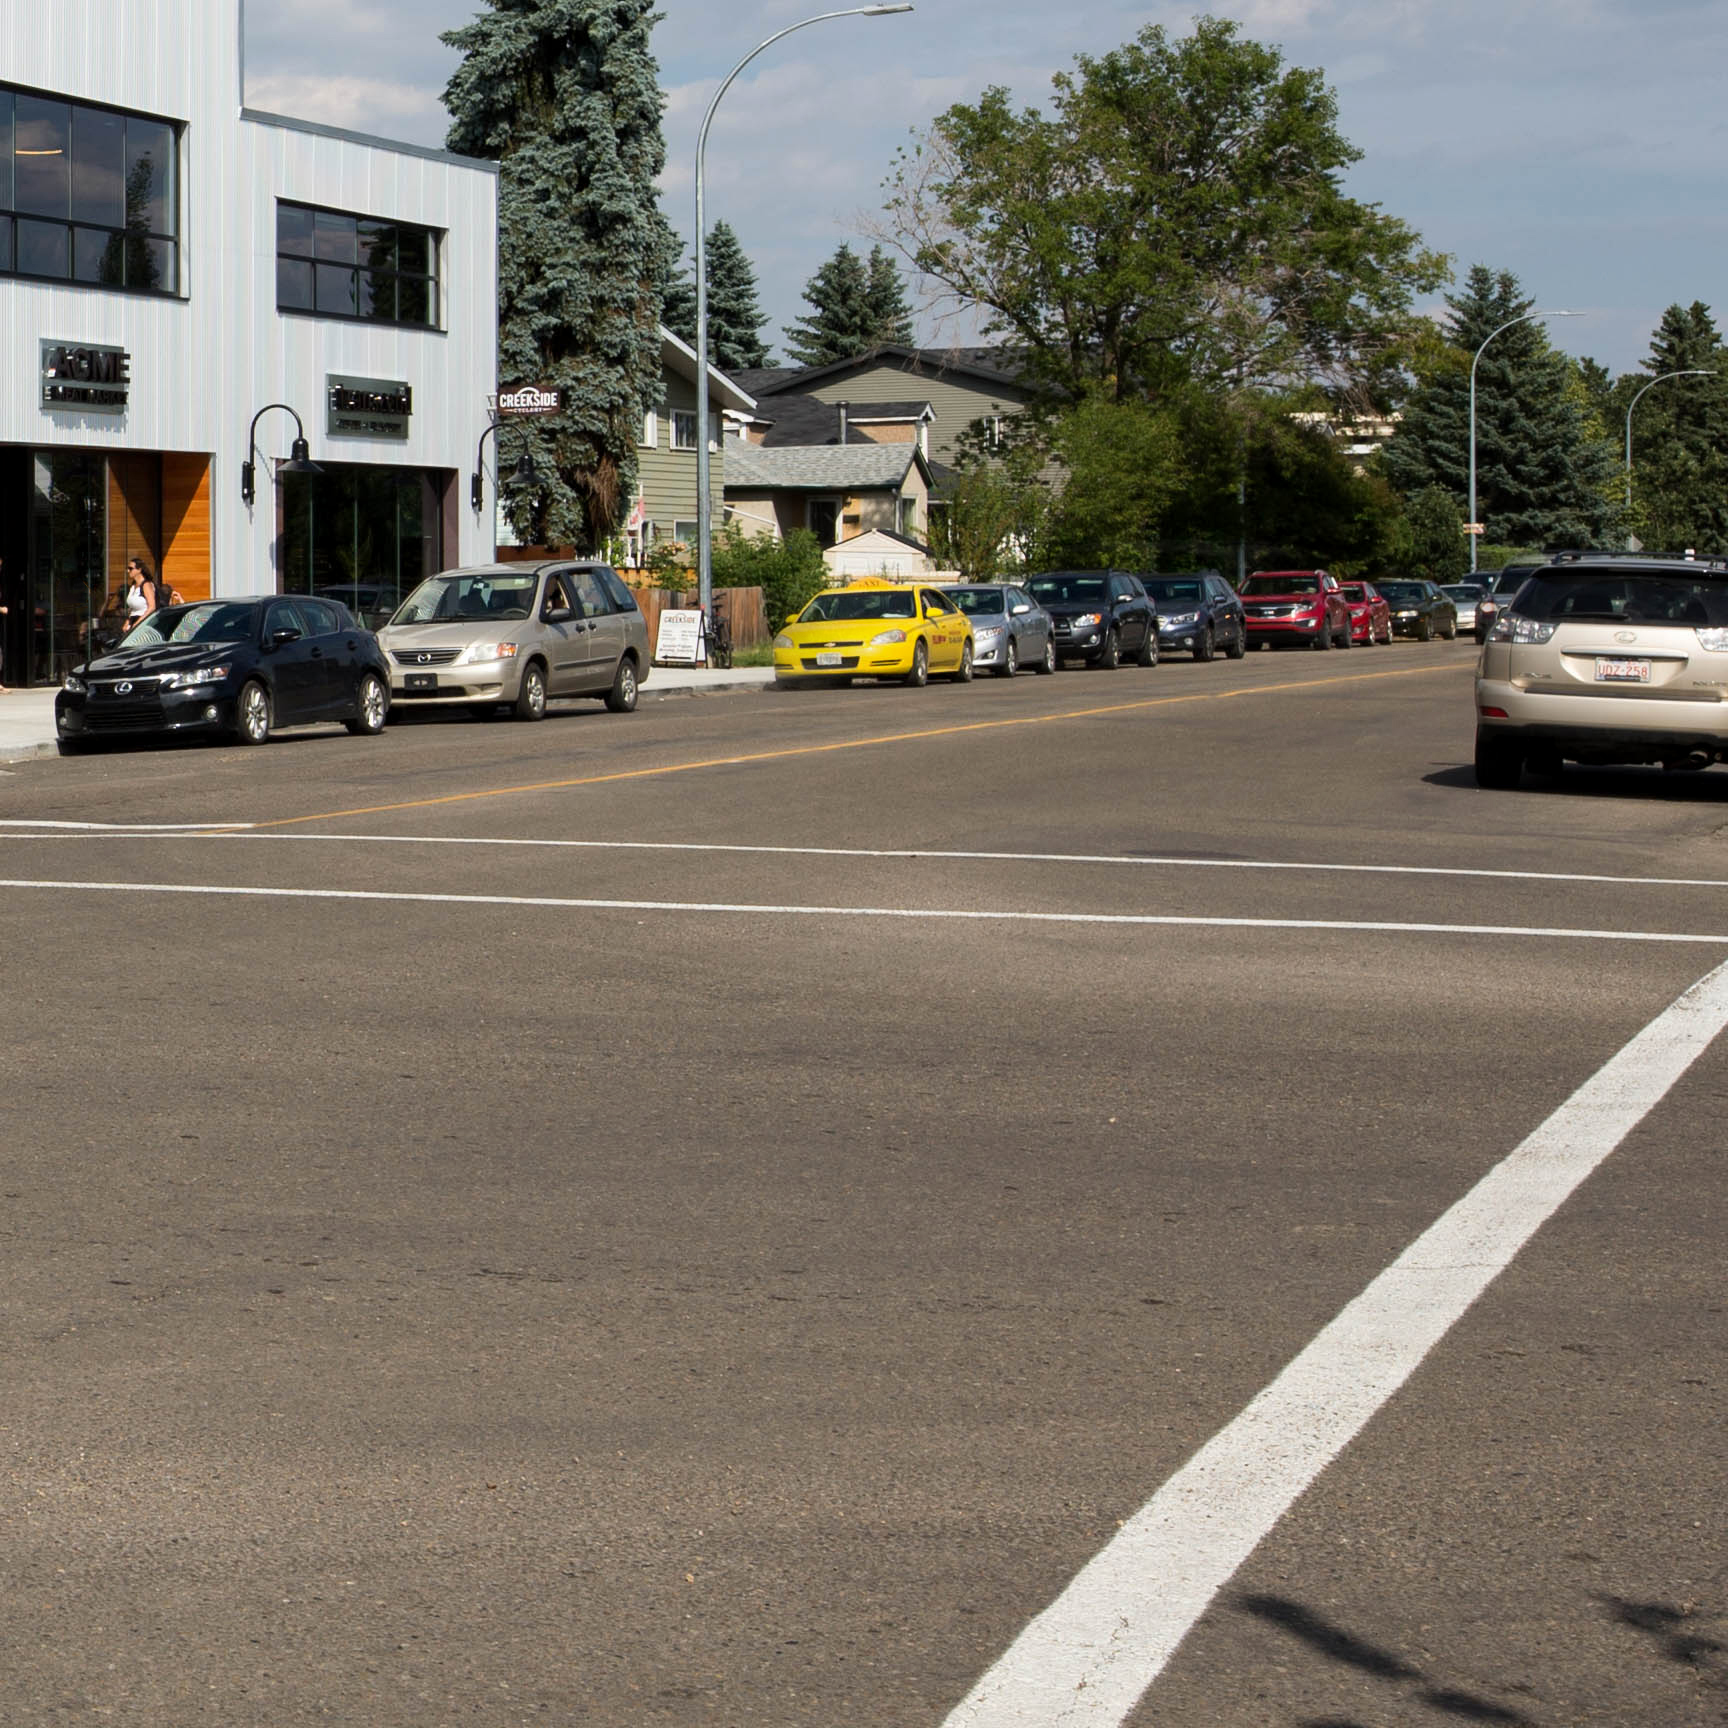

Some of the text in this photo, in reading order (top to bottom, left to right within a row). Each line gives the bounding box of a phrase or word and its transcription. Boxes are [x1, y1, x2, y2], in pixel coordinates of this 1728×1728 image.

[51, 346, 130, 384] ACME
[499, 393, 558, 408] CREEKSIDE
[1598, 663, 1648, 678] UDZ-258
